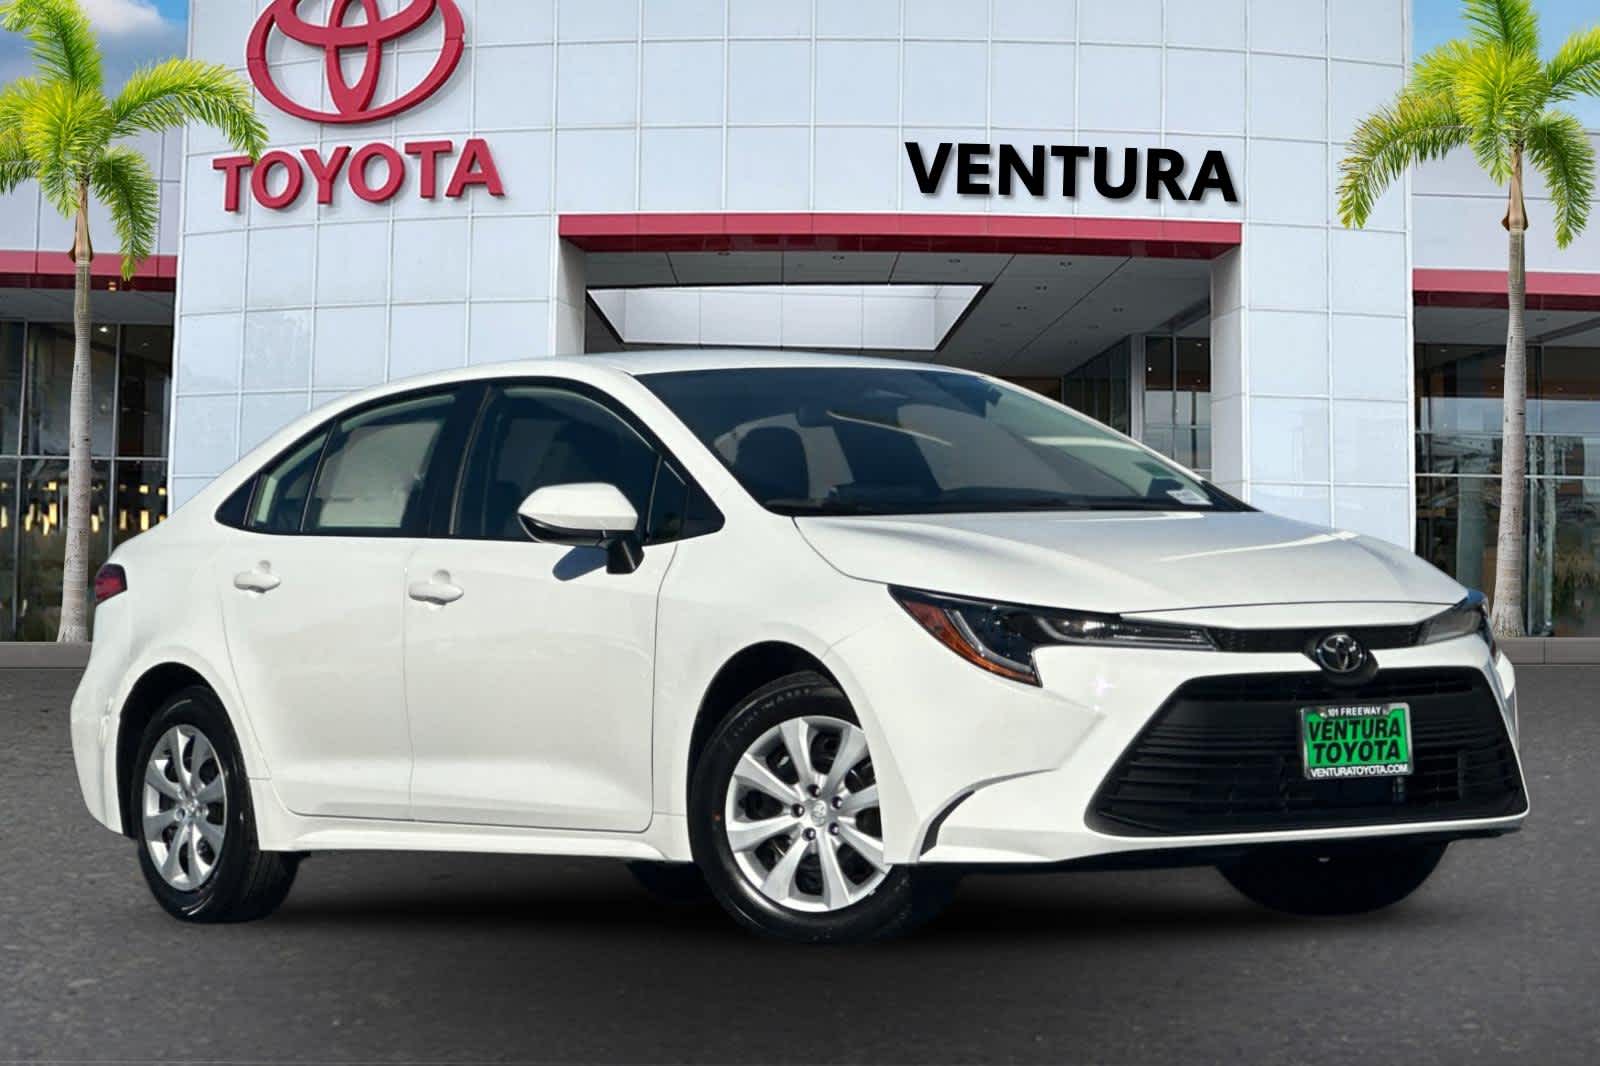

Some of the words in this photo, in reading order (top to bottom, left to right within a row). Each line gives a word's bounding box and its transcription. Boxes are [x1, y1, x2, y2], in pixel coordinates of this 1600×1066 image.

[213, 139, 505, 213] TOYOTA
[904, 142, 1238, 203] VENTURA
[1328, 708, 1339, 717] 101
[1340, 706, 1382, 716] FREEWAY
[1309, 718, 1401, 742] VENTURA
[1313, 739, 1401, 764] TOYOTA
[1311, 764, 1408, 778] VENTURATOYOTA.COM
